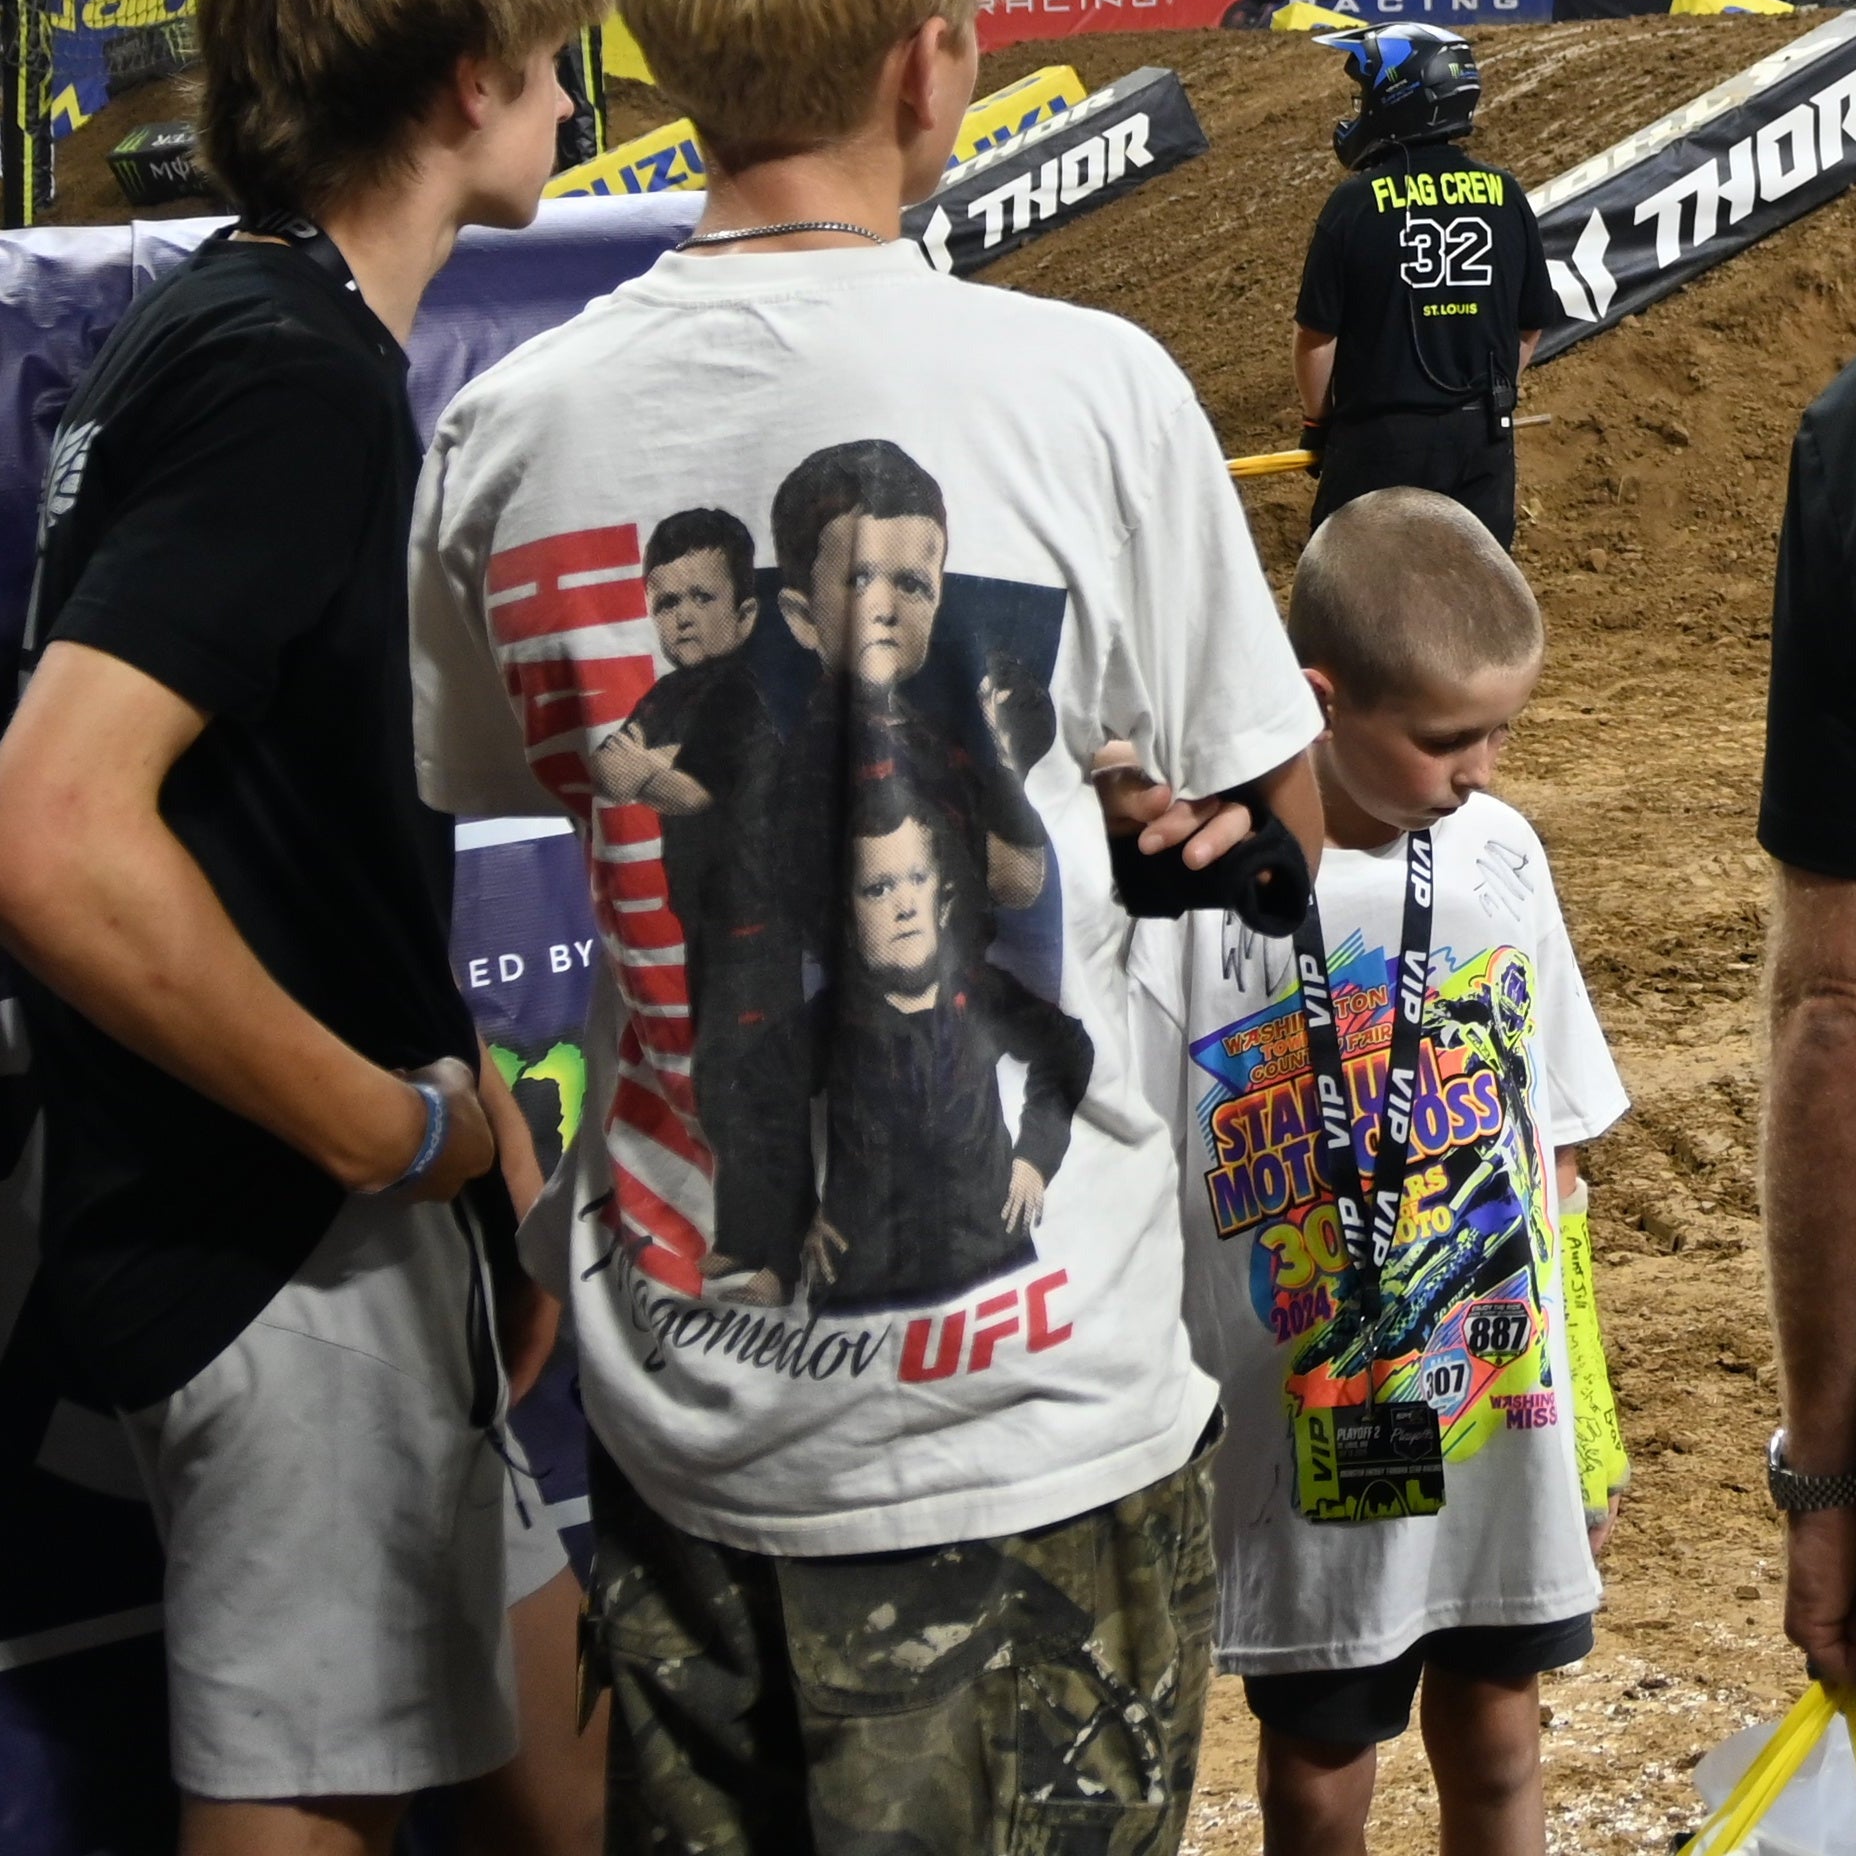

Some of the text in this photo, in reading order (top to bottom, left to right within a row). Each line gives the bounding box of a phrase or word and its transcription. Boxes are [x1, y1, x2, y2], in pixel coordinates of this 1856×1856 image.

[967, 111, 1155, 250] THOR
[1371, 170, 1504, 214] FLAG CREW
[1400, 216, 1493, 289] 32
[1410, 836, 1434, 909] VIP
[549, 939, 594, 975] BY
[1297, 953, 1331, 1030] VIP
[1400, 949, 1428, 1025] VIP
[1346, 1022, 1393, 1052] FAIR
[1316, 1074, 1352, 1151] VIP
[1387, 1067, 1416, 1145] VIP
[1258, 1204, 1346, 1289] 30
[1337, 1195, 1366, 1272] VIP
[1371, 1189, 1399, 1268] VIP
[1393, 1204, 1453, 1245] OTO
[898, 1268, 1075, 1384] UFC
[1270, 1286, 1336, 1344] 2024
[1469, 1316, 1528, 1352] 887
[1425, 1363, 1465, 1402] 307
[1308, 1416, 1333, 1482] VIP
[1337, 1425, 1382, 1442] PLAYOFF 2
